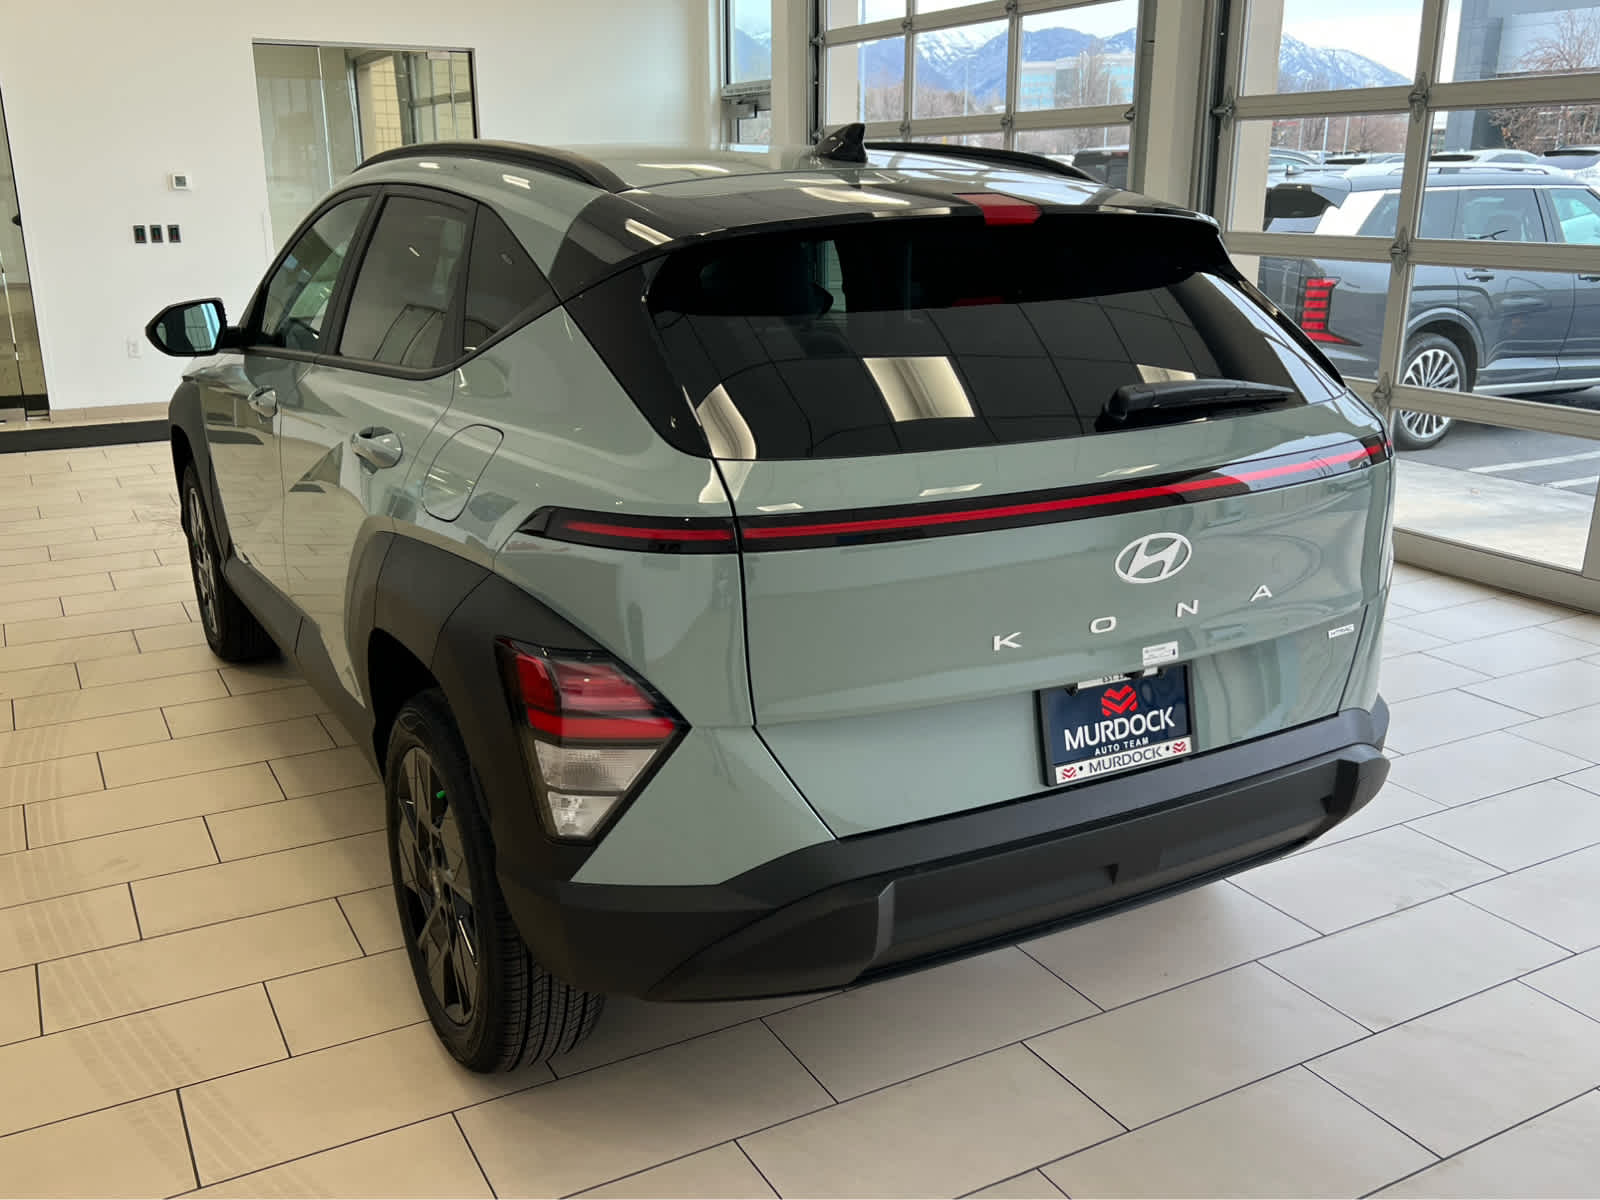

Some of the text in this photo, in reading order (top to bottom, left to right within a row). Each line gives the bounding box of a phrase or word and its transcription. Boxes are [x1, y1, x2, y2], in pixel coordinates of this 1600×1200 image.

[993, 584, 1273, 652] KONA
[1064, 706, 1176, 751] MURDOCK
[1094, 736, 1150, 756] AUTO TEAM
[1088, 746, 1163, 774] MURDOCK
